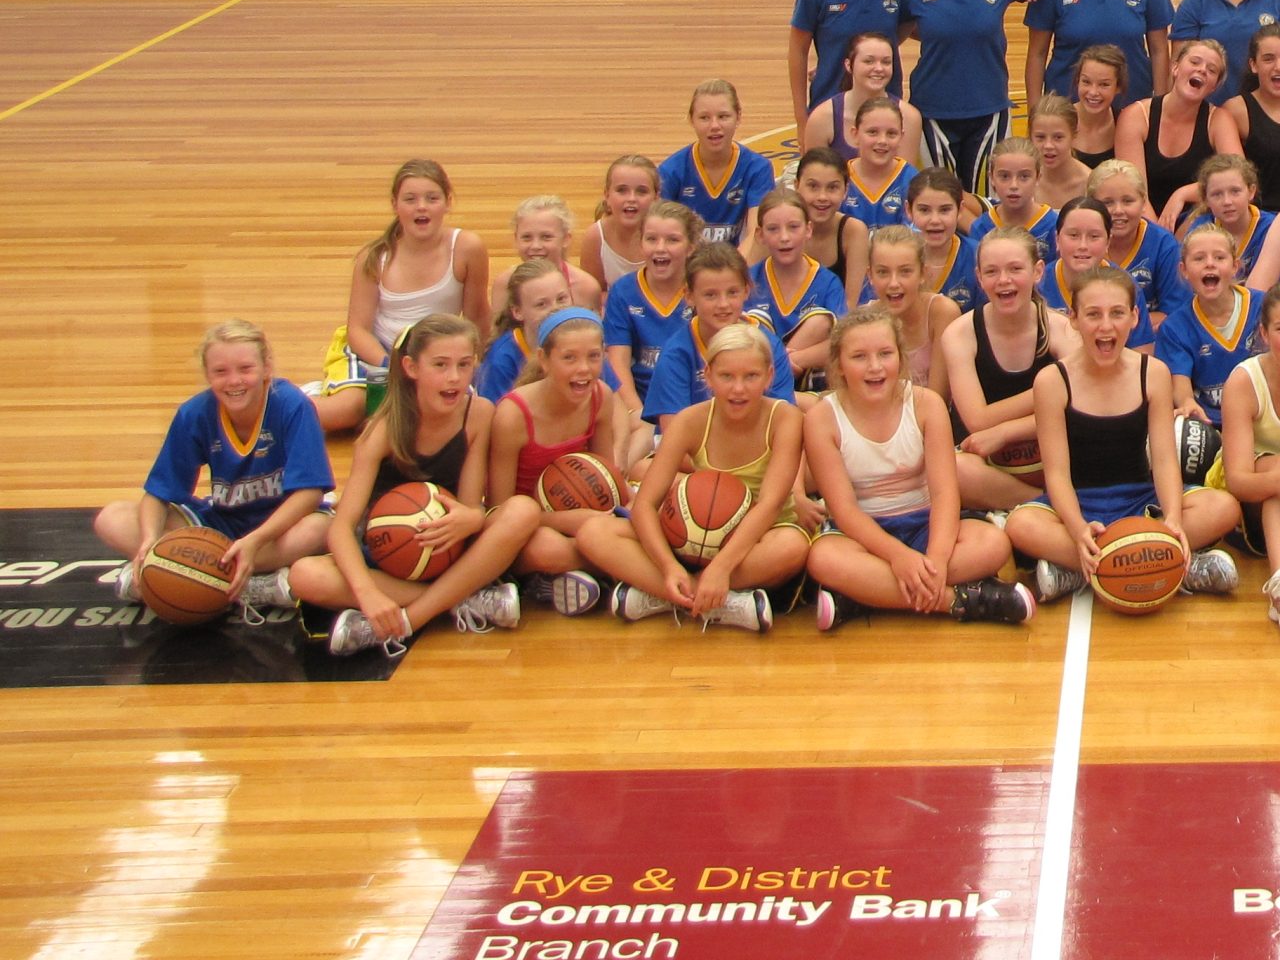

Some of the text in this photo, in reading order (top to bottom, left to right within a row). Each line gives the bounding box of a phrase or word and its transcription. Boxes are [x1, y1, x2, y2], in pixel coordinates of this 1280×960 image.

[1185, 419, 1201, 475] molten
[1112, 548, 1174, 569] molten
[511, 865, 892, 898] Rye & District
[496, 893, 1001, 927] Community Bank
[473, 934, 679, 960] Branch
